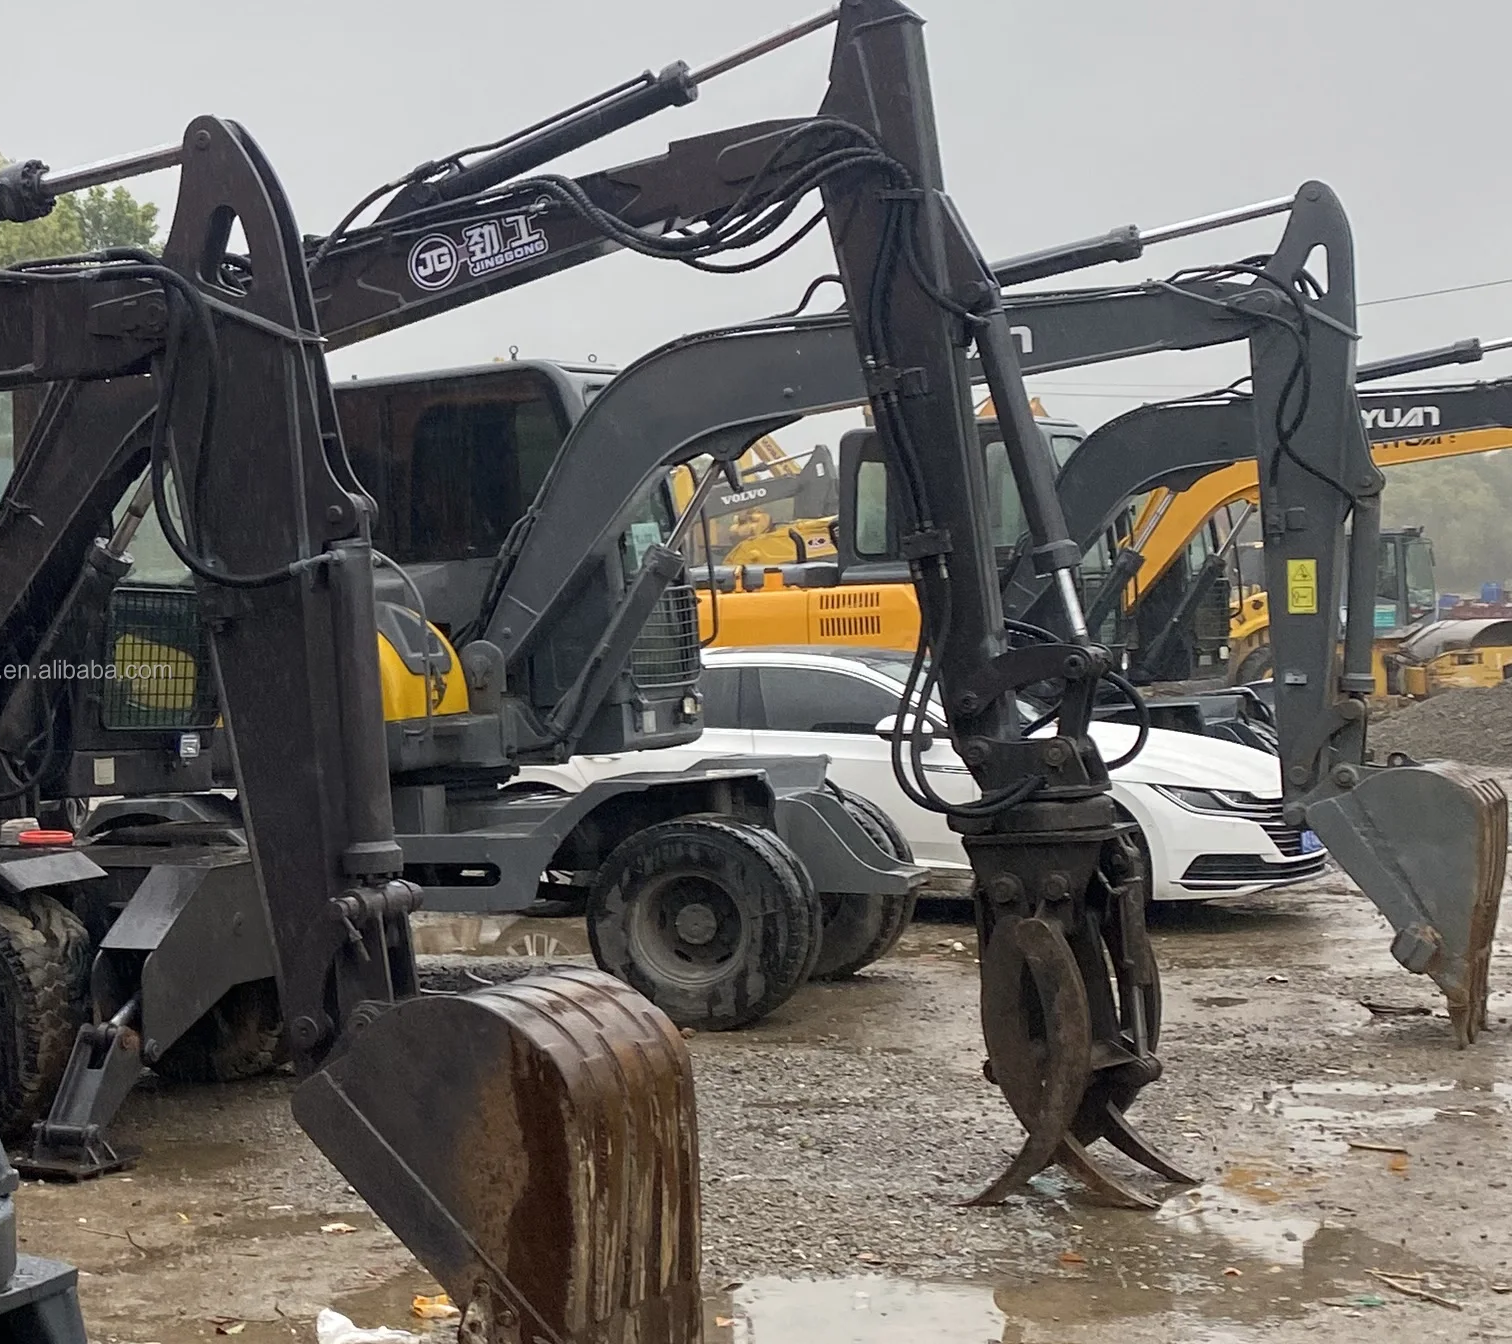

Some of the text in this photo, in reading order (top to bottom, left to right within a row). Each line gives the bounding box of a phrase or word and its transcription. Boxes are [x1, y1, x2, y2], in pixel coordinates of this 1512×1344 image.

[466, 214, 541, 262] 劲工
[417, 245, 452, 277] JG
[473, 240, 545, 273] JINGGONG
[1360, 405, 1440, 429] YUAN
[720, 487, 767, 505] VOLVO
